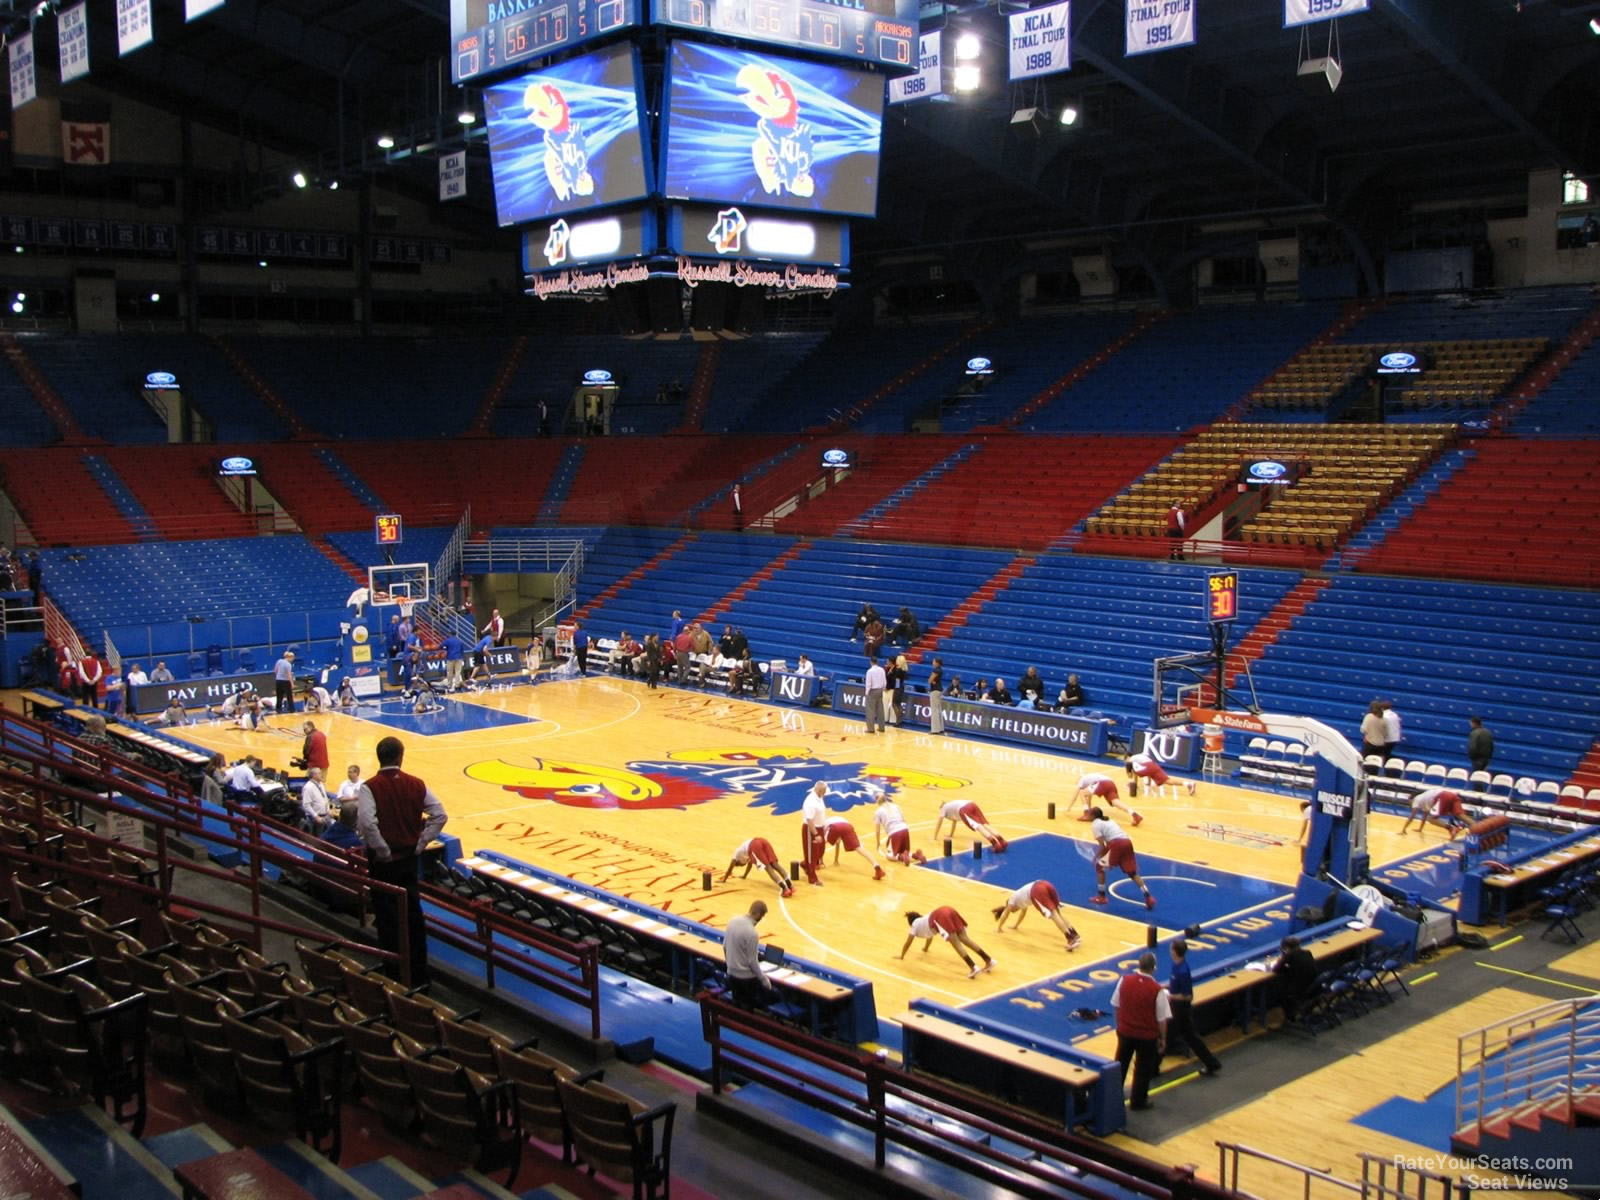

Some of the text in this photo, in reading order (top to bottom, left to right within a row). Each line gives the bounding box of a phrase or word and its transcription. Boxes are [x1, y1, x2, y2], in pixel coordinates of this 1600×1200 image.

[1130, 0, 1191, 23] FINAL FOUR
[555, 19, 562, 40] 0
[875, 20, 912, 38] ARKANSAS
[1024, 12, 1053, 32] NCAA
[824, 23, 833, 45] 0
[856, 34, 865, 53] 5
[1012, 28, 1065, 50] FINAL FOUR
[1146, 25, 1172, 44] 1991
[897, 41, 907, 62] 0
[1026, 52, 1051, 71] 1988
[903, 77, 925, 95] 1986
[534, 261, 649, 300] Russell Stover Candies
[676, 255, 838, 290] Russell Stover Candies
[1384, 354, 1411, 366] Ford
[1254, 463, 1281, 476] Ford
[381, 526, 396, 540] 30
[1212, 590, 1231, 617] 30
[469, 653, 514, 668] ETER
[167, 687, 197, 700] PAY
[779, 674, 805, 700] KU
[914, 705, 932, 718] TO
[991, 718, 1088, 744] FIELDHOUSE
[1143, 731, 1181, 763] KU
[1303, 732, 1319, 746] KU
[1318, 790, 1351, 807] MUSCLE
[580, 830, 689, 864] Fieldhouse
[475, 821, 752, 903] JAYHAWKS
